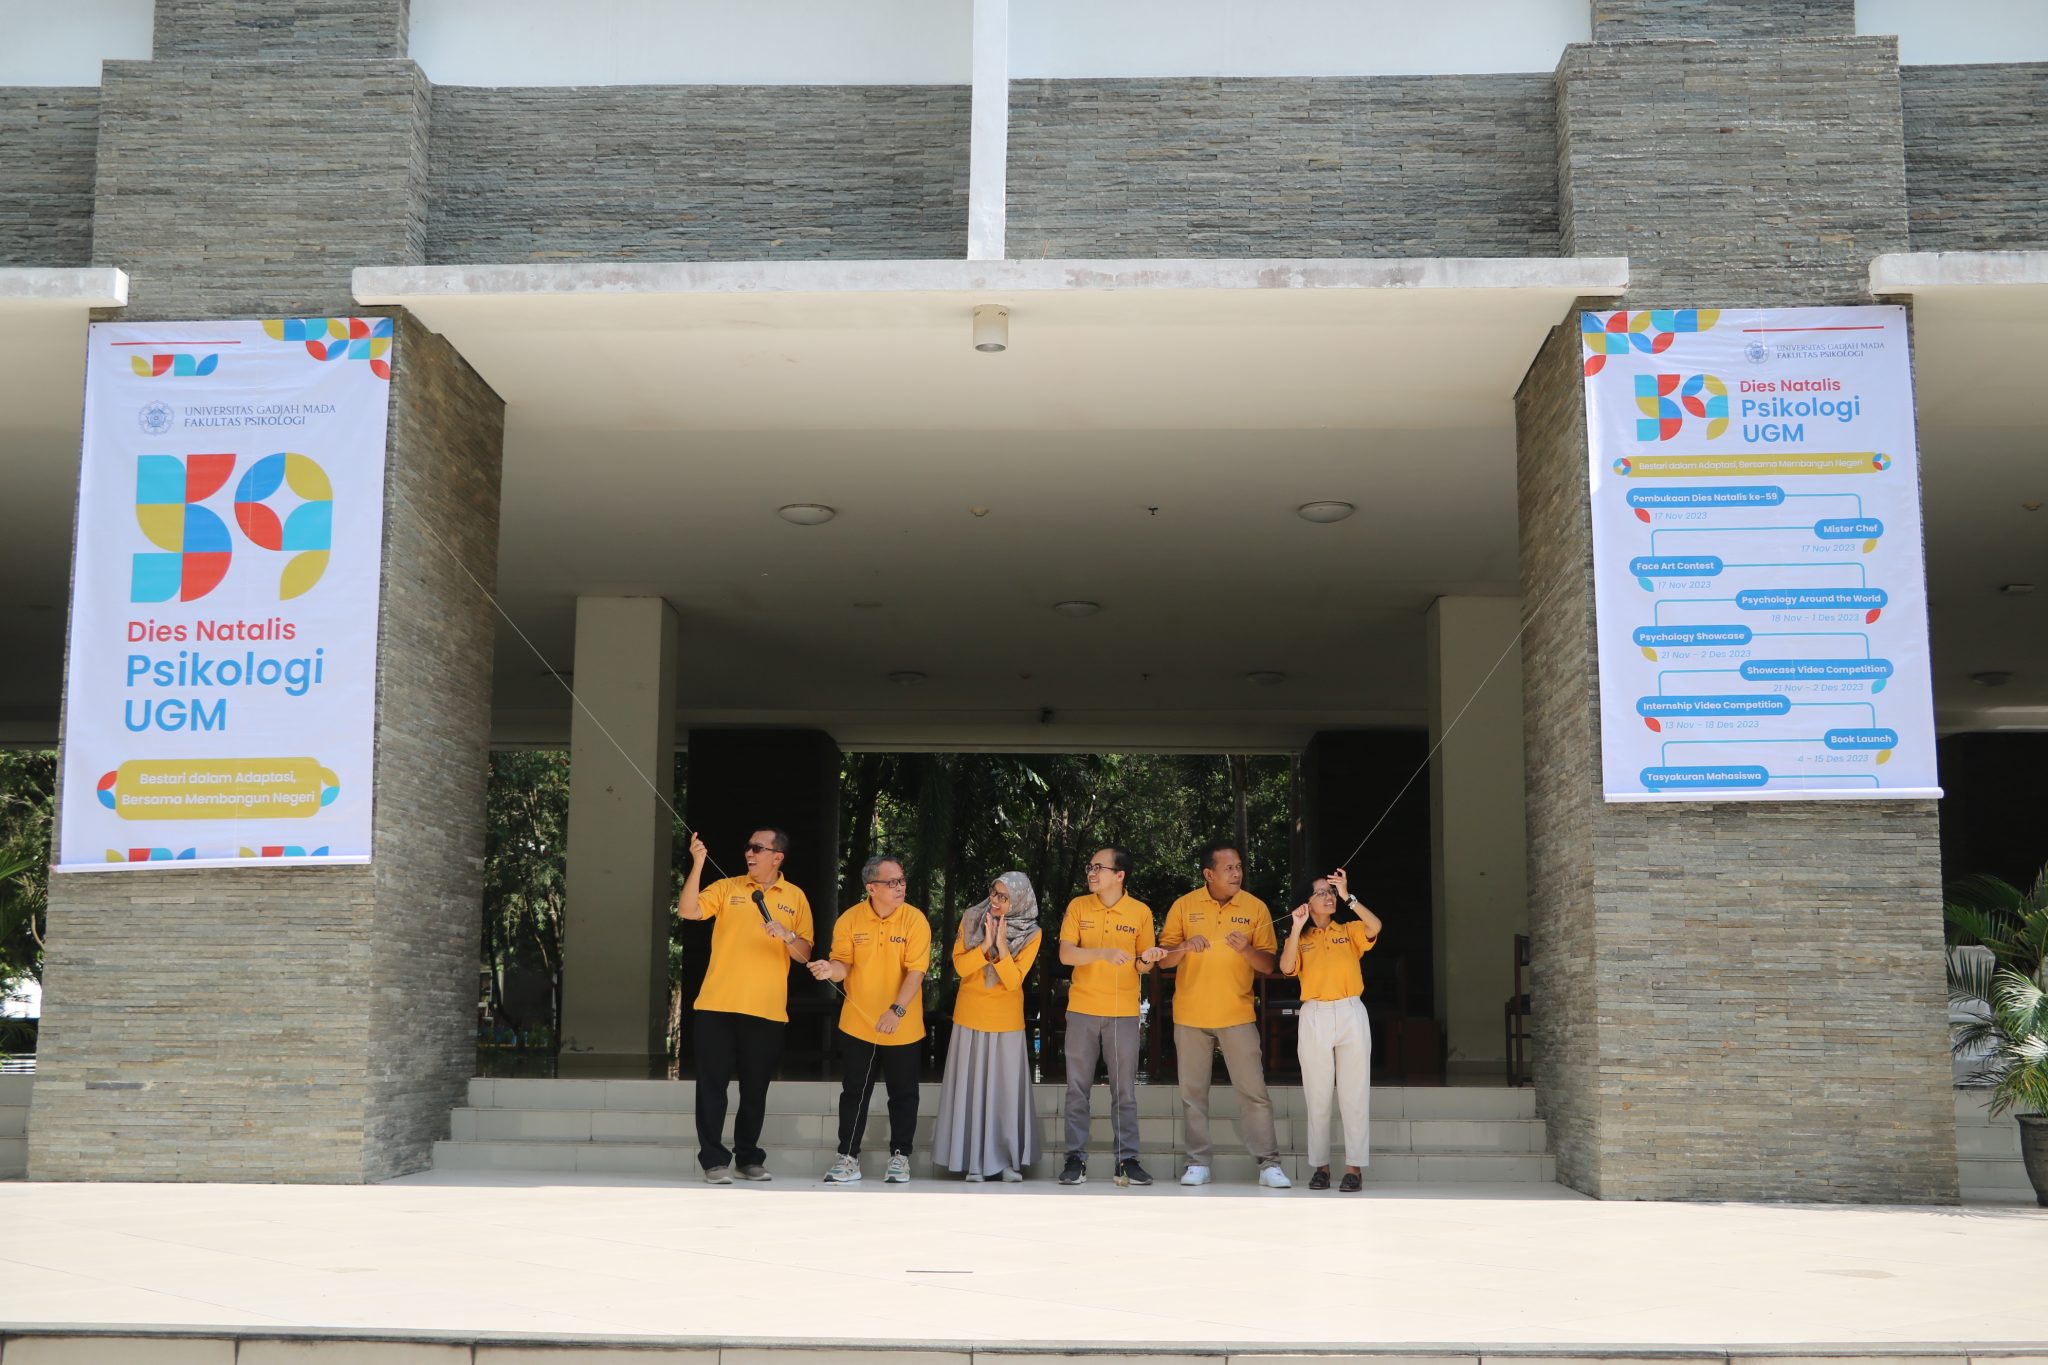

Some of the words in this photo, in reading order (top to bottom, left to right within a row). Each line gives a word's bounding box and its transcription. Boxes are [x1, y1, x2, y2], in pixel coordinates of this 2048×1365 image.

[1828, 343, 1859, 351] GADJAH
[1777, 351, 1819, 359] FAKULTAS
[1820, 350, 1864, 358] PSIKOLOGI
[1740, 379, 1776, 393] Dies
[1780, 378, 1841, 392] Natalis
[185, 405, 254, 416] UNIVERSITAS
[256, 405, 300, 416] GADJAH
[302, 404, 336, 414] MADA
[1741, 395, 1860, 423] Psikologi
[184, 417, 241, 427] FAKULTAS
[244, 416, 305, 426] PSIKOLOGI
[1743, 423, 1804, 443] UGM
[1639, 462, 1668, 470] Bestari
[1739, 461, 1777, 469] Bersama
[1779, 460, 1834, 469] Membangun
[1835, 459, 1863, 468] Negeri
[1633, 494, 1690, 503] Pembukaan
[1692, 493, 1712, 502] Dies
[1714, 493, 1747, 501] Natalis
[1748, 492, 1777, 501] ke-59
[1654, 512, 1662, 520] 17
[1665, 512, 1684, 520] Nov
[1685, 511, 1707, 520] 2023
[1823, 525, 1854, 533] Mister
[1855, 524, 1878, 533] Chef
[1801, 544, 1810, 552] 17
[1813, 544, 1831, 553] Nov
[1833, 543, 1856, 552] 2023
[1636, 562, 1659, 570] Face
[1661, 562, 1675, 570] Art
[1676, 561, 1714, 570] Contest
[1657, 581, 1666, 589] 17
[1668, 581, 1686, 589] Nov
[1688, 581, 1711, 589] 2023
[1741, 595, 1797, 605] Psychology
[1799, 594, 1834, 603] Around
[1836, 594, 1851, 602] the
[1852, 594, 1881, 603] World
[1771, 614, 1781, 622] 18
[1783, 614, 1802, 622] Nov
[1837, 613, 1860, 621] 2023
[127, 619, 187, 642] Dies
[196, 617, 296, 641] Natalis
[1640, 633, 1695, 643] Psychology
[1696, 632, 1745, 640] Showcase
[1661, 651, 1670, 659] 21
[1671, 651, 1690, 659] Nov
[1729, 650, 1751, 658] 2023
[126, 648, 324, 697] Psikologi
[1747, 666, 1796, 675] Showcase
[1797, 666, 1825, 674] Video
[1825, 665, 1887, 675] Competition
[1773, 684, 1783, 692] 21
[1784, 684, 1802, 692] Nov
[1813, 684, 1819, 692] 2
[1821, 684, 1839, 692] Des
[1841, 683, 1864, 691] 2023
[1643, 702, 1693, 711] Internship
[1694, 701, 1721, 709] Video
[1723, 700, 1783, 711] Competition
[125, 698, 227, 732] UGM
[1676, 721, 1695, 729] Nov
[1705, 721, 1714, 729] 18
[1716, 721, 1734, 729] Des
[1736, 720, 1760, 728] 2023
[1830, 736, 1855, 744] Book
[1856, 735, 1892, 743] Launch
[1815, 755, 1824, 763] 15
[140, 771, 186, 785] Bestari
[188, 771, 232, 784] dalam
[235, 770, 297, 786] Adaptasi,
[1647, 773, 1705, 783] Tasyakuran
[1706, 772, 1762, 780] Mahasiswa
[121, 794, 181, 805] Bersama
[185, 792, 270, 807] Membangun
[272, 791, 315, 806] Negeri
[777, 903, 796, 916] UGM
[1231, 916, 1251, 925] UGM
[1115, 924, 1136, 934] UGM
